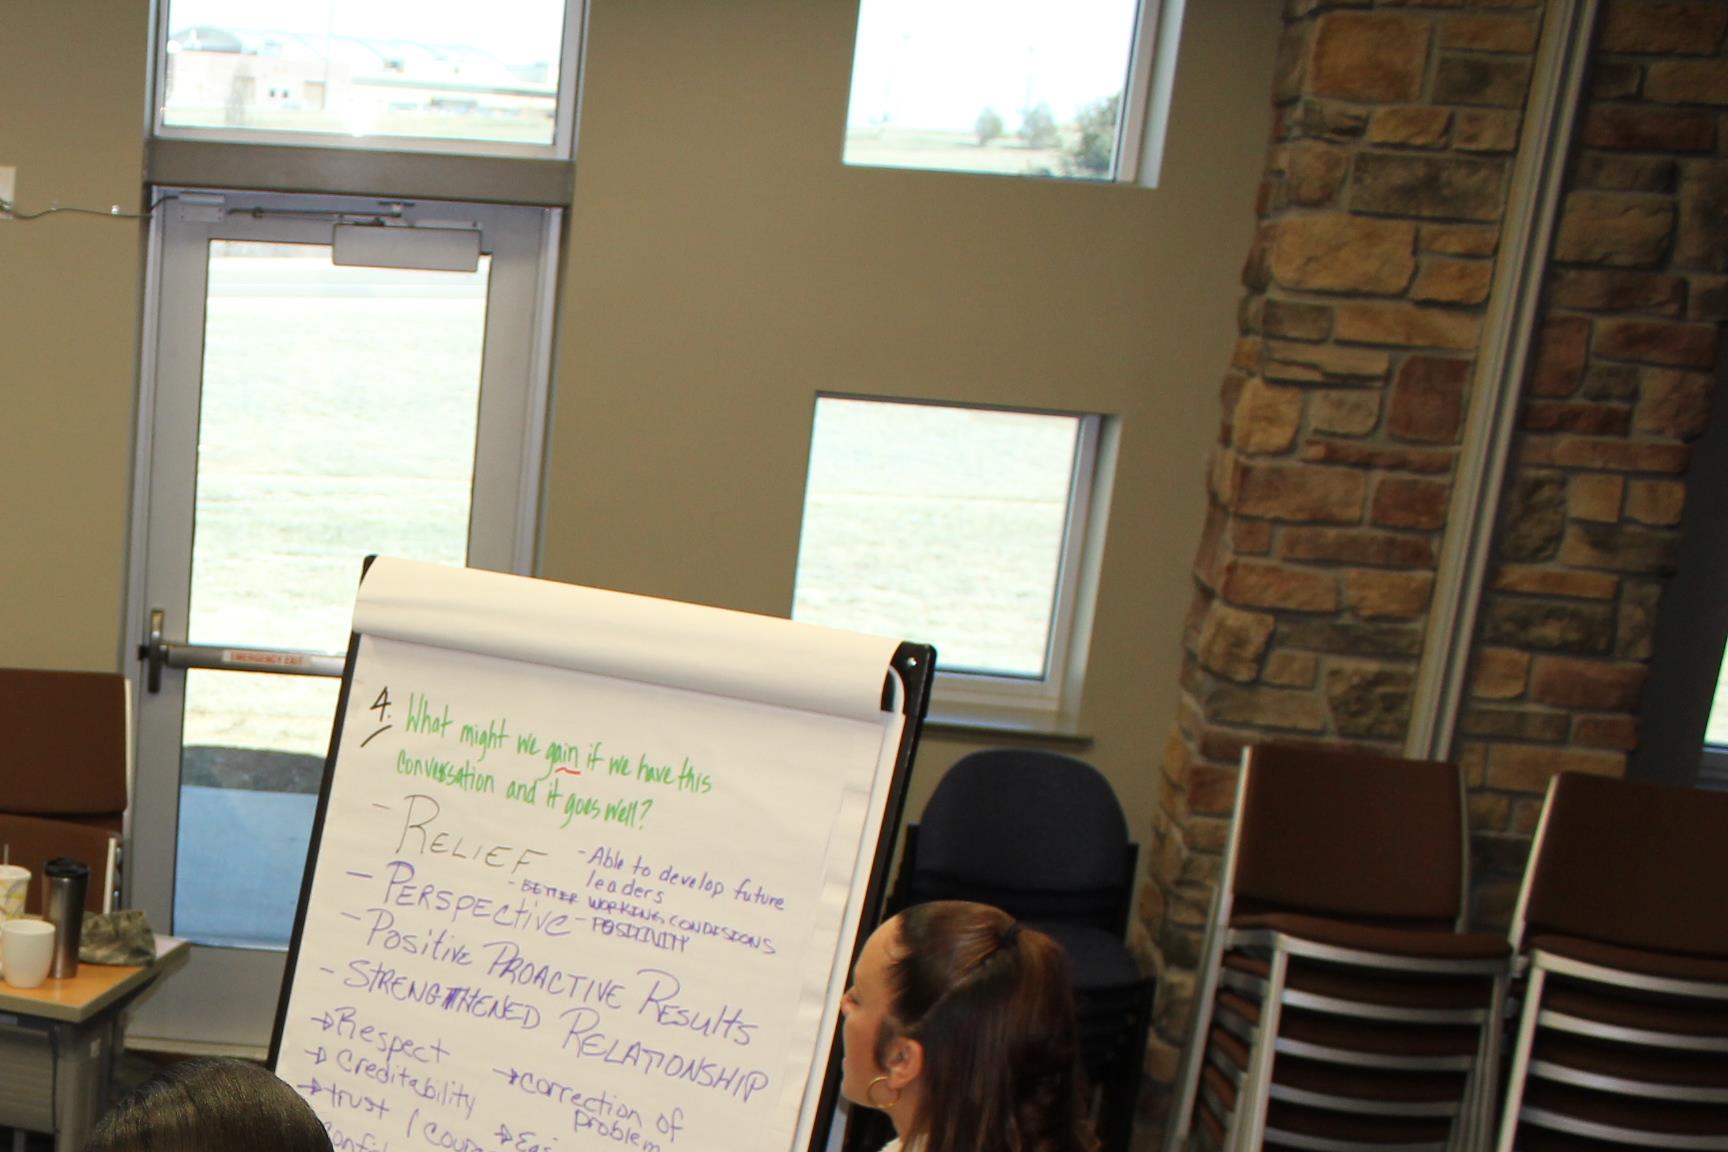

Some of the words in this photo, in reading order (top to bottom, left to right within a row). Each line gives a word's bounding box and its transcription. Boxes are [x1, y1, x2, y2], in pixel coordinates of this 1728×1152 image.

[406, 693, 453, 738] What
[461, 718, 509, 762] might
[517, 733, 540, 755] we
[536, 741, 578, 782] gain
[586, 742, 603, 769] if
[609, 755, 632, 776] we
[637, 754, 673, 785] have
[673, 757, 712, 795] this
[506, 780, 538, 806] and
[547, 778, 563, 808] it
[560, 792, 600, 829] goes
[395, 794, 548, 874] RELIEF
[586, 870, 665, 904] leaders
[633, 856, 651, 878] to
[659, 865, 724, 898] develop
[734, 879, 785, 911] future
[482, 941, 626, 1009] PROACTIVE
[335, 1006, 451, 1063] Respect
[559, 1007, 769, 1103] RELATIONSHIP
[323, 1083, 390, 1119] trust
[657, 1107, 684, 1143] of
